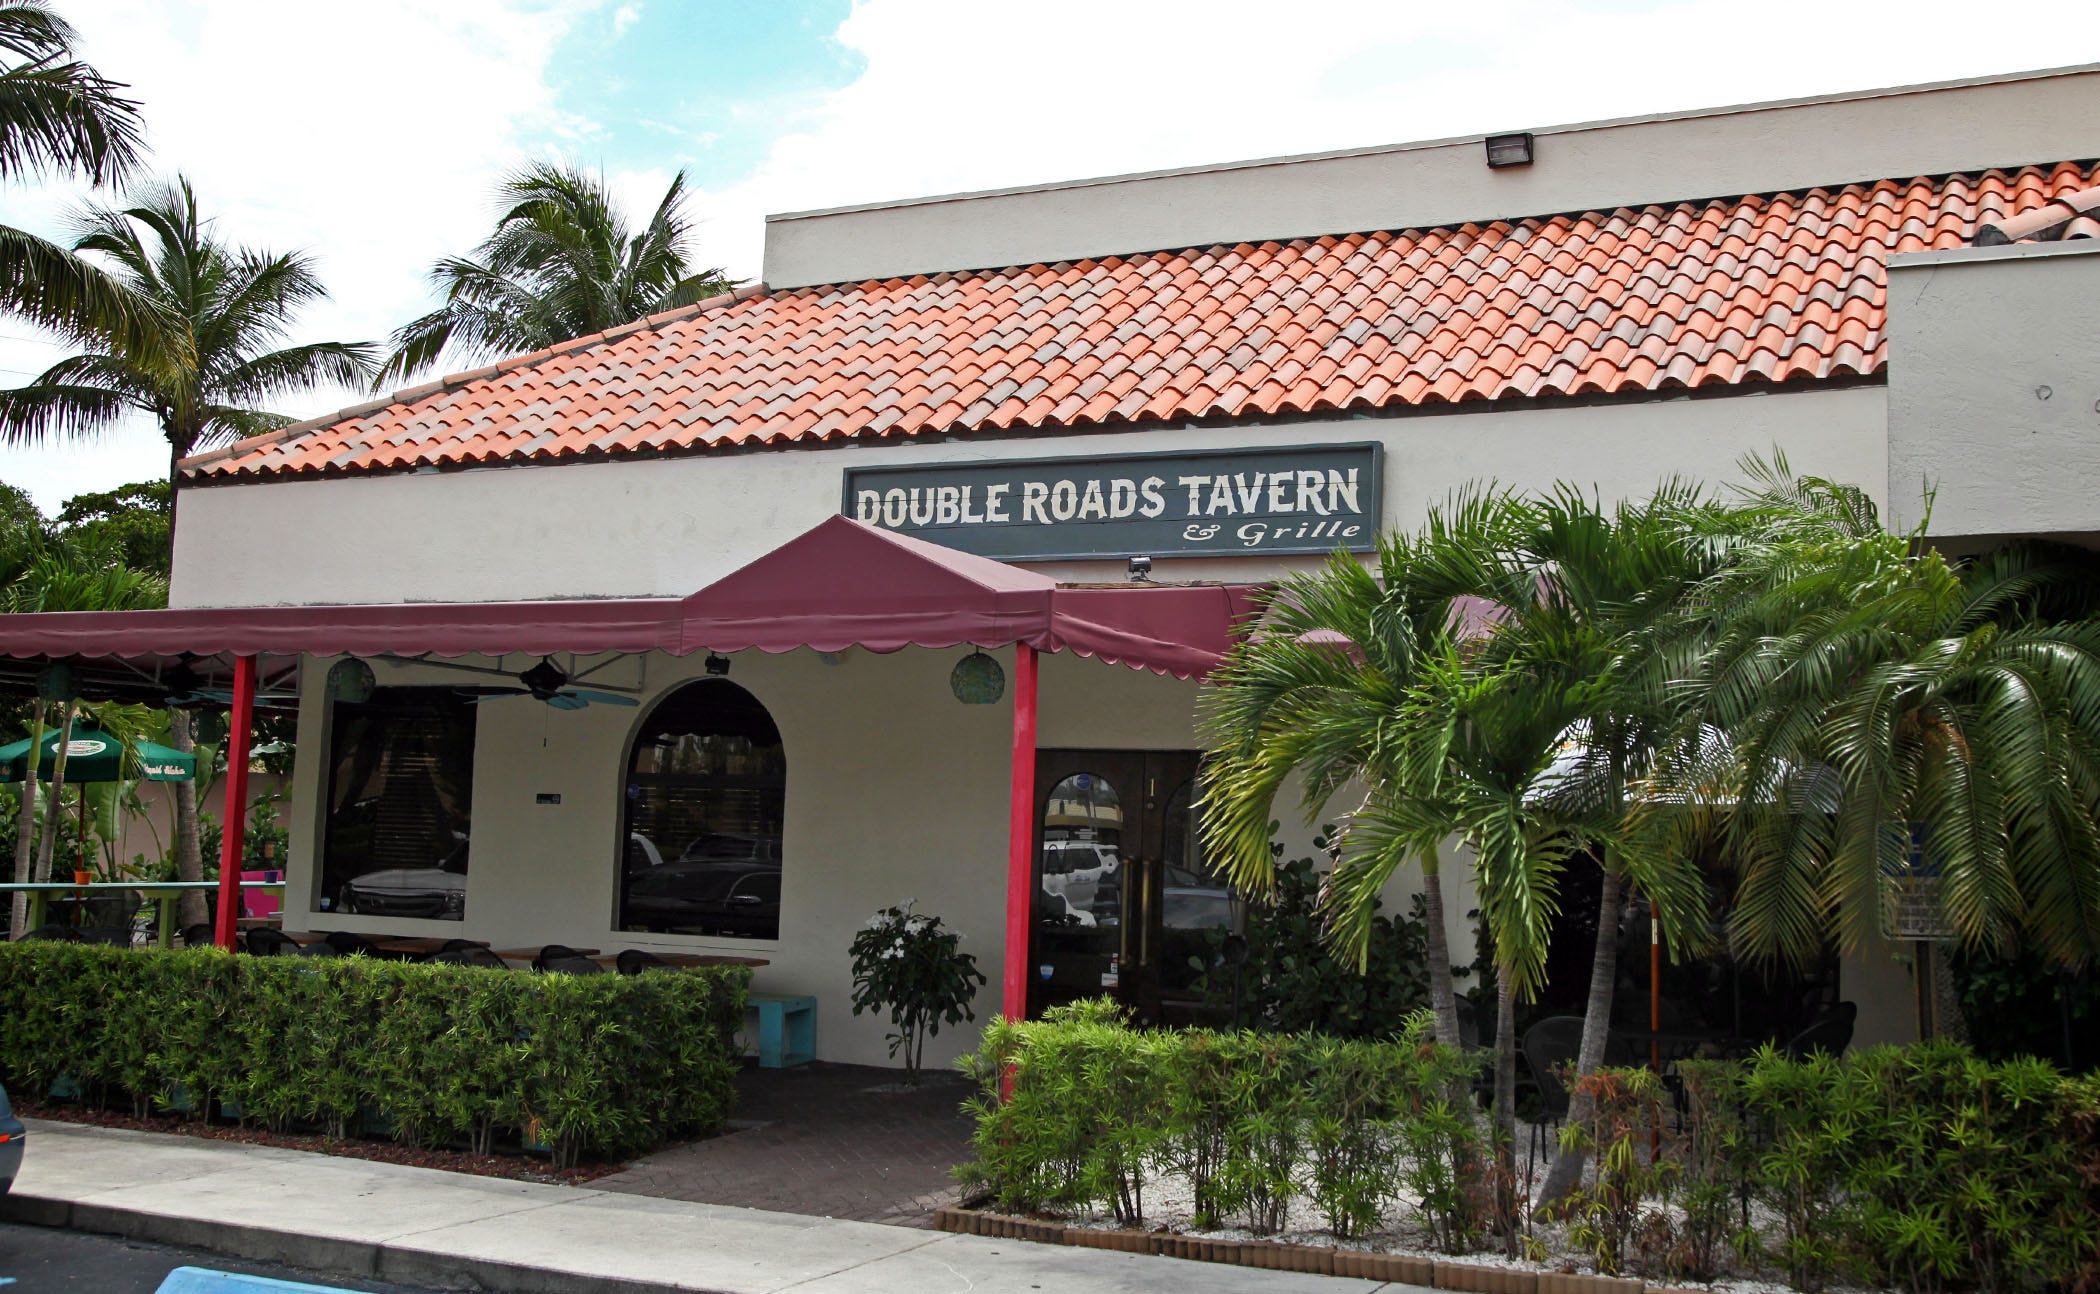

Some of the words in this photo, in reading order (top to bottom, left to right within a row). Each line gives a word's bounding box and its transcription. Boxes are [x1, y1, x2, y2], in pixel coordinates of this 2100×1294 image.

[857, 482, 1010, 527] DOUBLE
[1022, 475, 1166, 525] ROADS
[1179, 467, 1363, 516] TAVERN
[1182, 524, 1221, 541] &
[1236, 520, 1361, 547] Grille
